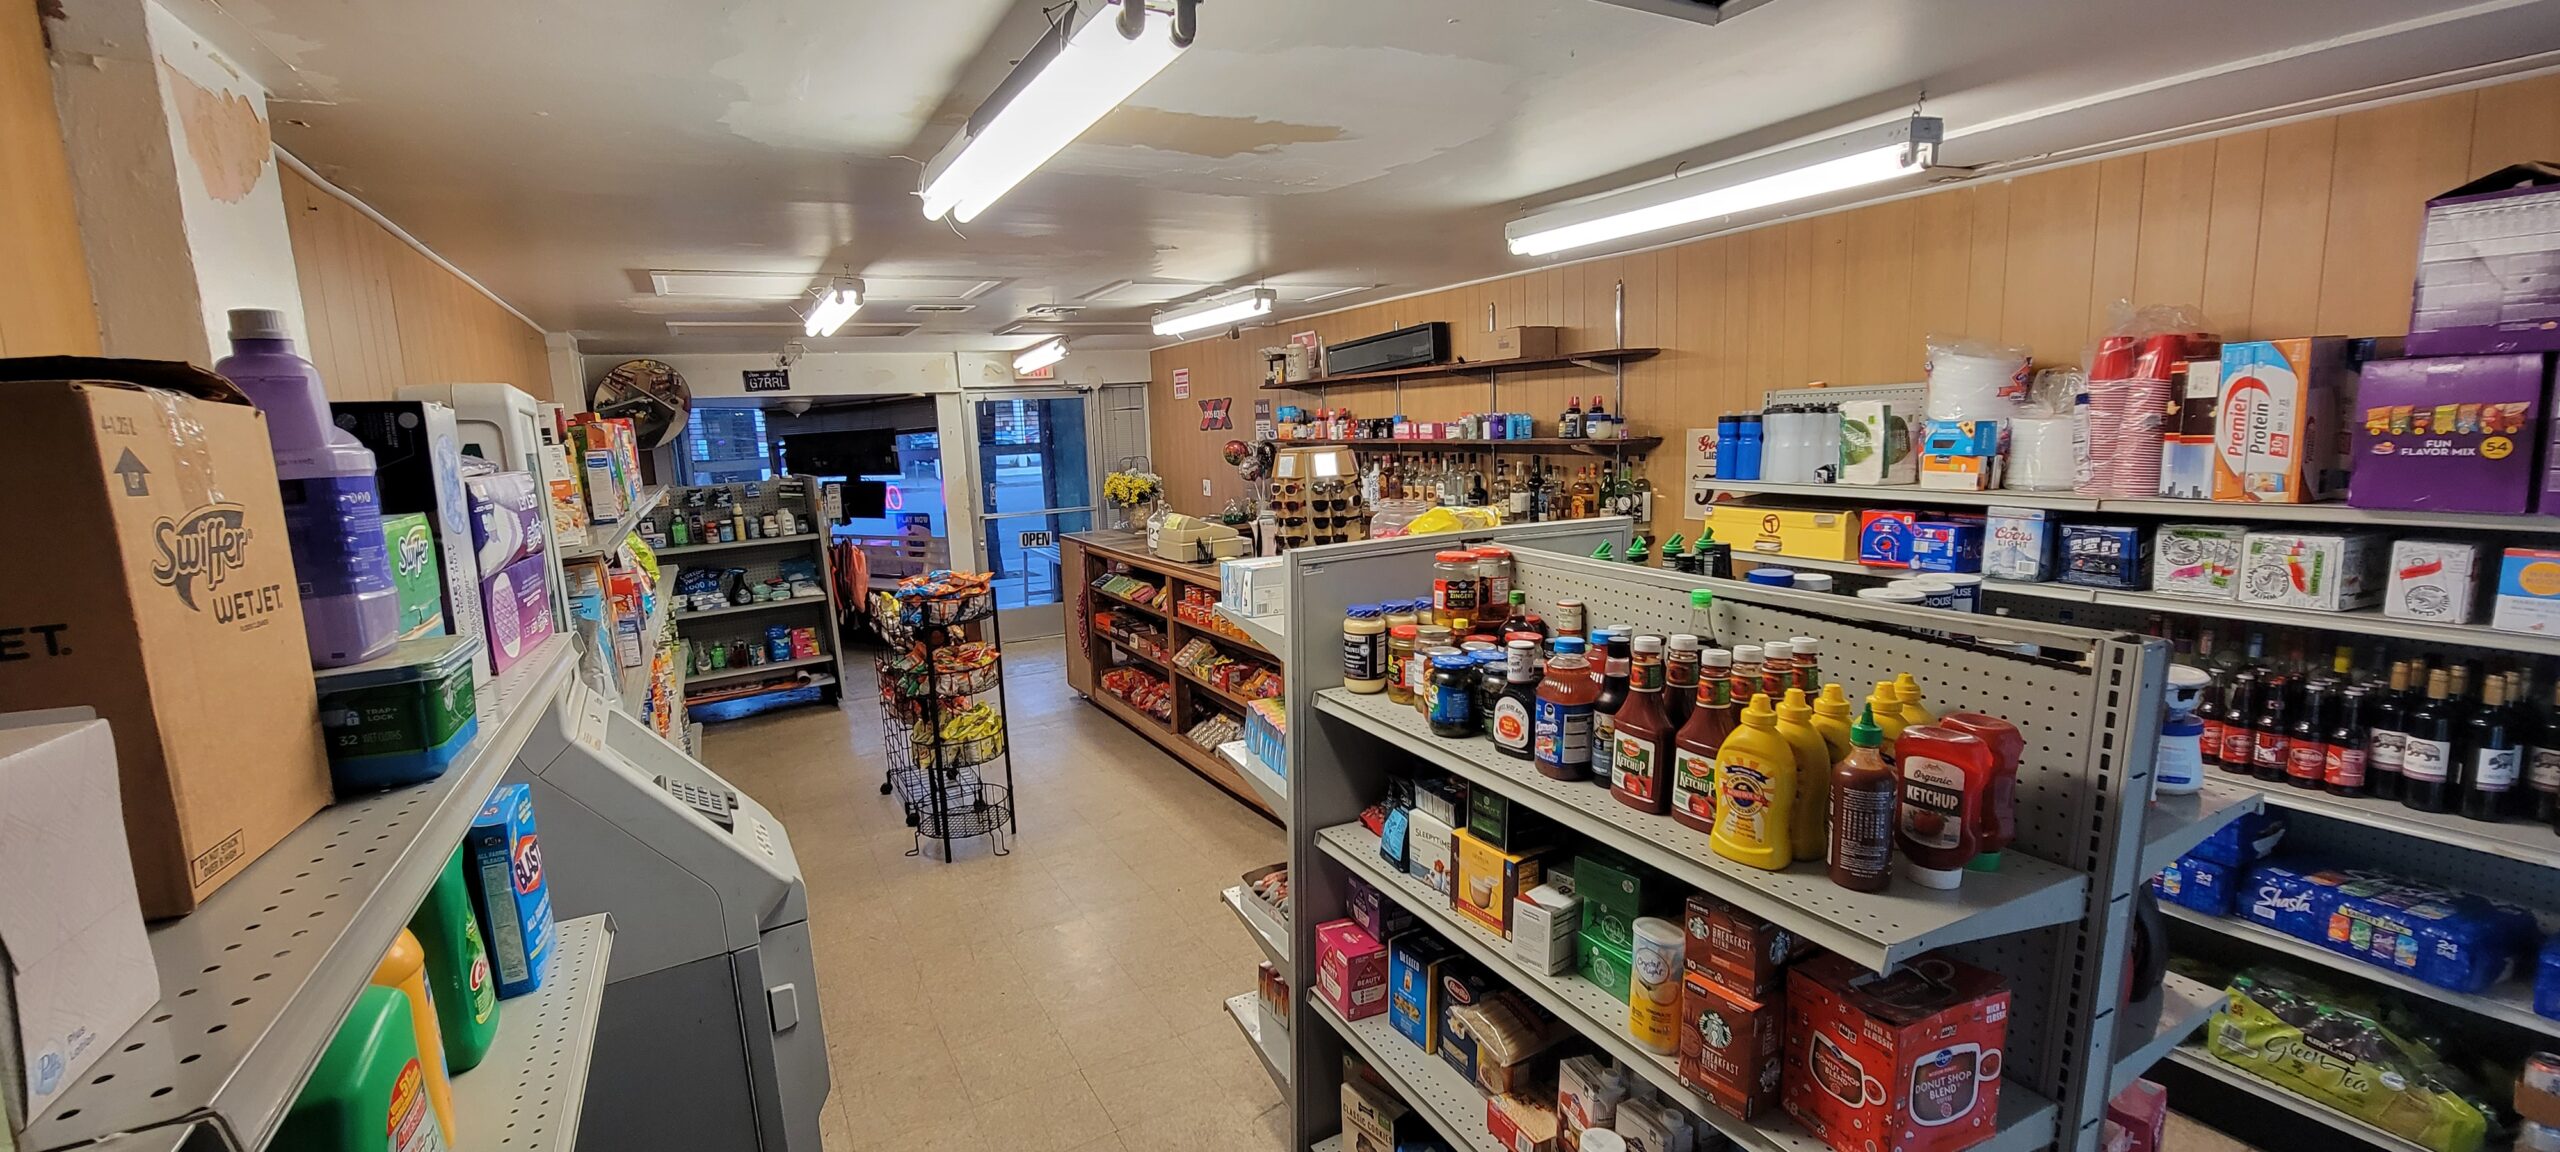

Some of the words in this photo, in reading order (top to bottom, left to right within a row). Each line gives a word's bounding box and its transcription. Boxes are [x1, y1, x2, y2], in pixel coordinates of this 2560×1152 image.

[750, 377, 787, 388] G7RRL
[2228, 396, 2248, 457] Premier
[2250, 401, 2269, 455] Protein
[2401, 448, 2449, 456] FLAVOR
[2452, 448, 2476, 456] MIX
[2426, 440, 2451, 448] FUN
[2486, 442, 2507, 452] 54
[1704, 451, 1717, 459] LIG
[1022, 533, 1050, 547] OPEN
[1995, 526, 2032, 542] Coors
[1997, 540, 2028, 549] LIGHT
[152, 516, 247, 591] Swiffer
[399, 534, 428, 578] Swiffer
[1952, 588, 1972, 596] USE
[213, 584, 281, 624] WETJET
[367, 713, 395, 722] LOCK
[338, 735, 358, 746] 32
[1617, 751, 1645, 776] KETCHUP
[1680, 771, 1716, 797] KETCHUP
[1914, 769, 1952, 785] Organic
[1907, 785, 1958, 810] KETCHUP
[1415, 828, 1451, 851] SLEEPYTIME
[2195, 870, 2213, 882] 24
[2256, 886, 2315, 915] Shasta
[1689, 903, 1709, 915] KEURIG
[1712, 927, 1751, 951] BREAKFAST
[1712, 936, 1729, 950] BLEND
[2436, 939, 2458, 953] 24
[1687, 958, 1697, 970] 10
[1357, 975, 1381, 986] BEAUTY
[1687, 982, 1706, 995] KEURIG
[1986, 1003, 2000, 1015] RICH
[1986, 1011, 2007, 1024] CLASSIC
[1864, 1019, 1883, 1033] RICH
[1863, 1027, 1894, 1052] CLASSIC
[2306, 1035, 2356, 1062] KIRKLAND
[1702, 1049, 1739, 1077] BREAKFAST
[1815, 1051, 1841, 1073] DONUT
[1840, 1068, 1861, 1088] SHOP
[2265, 1036, 2332, 1069] Green
[2335, 1066, 2370, 1093] Tea
[1680, 1075, 1690, 1088] 10
[1825, 1066, 1849, 1087] BLEND
[1915, 1076, 1947, 1095] DONUT
[1947, 1070, 1972, 1085] SHOP
[1929, 1085, 1957, 1101] BLEND
[1343, 1103, 1366, 1127] CLASSIC
[1367, 1121, 1393, 1146] COOKIES
